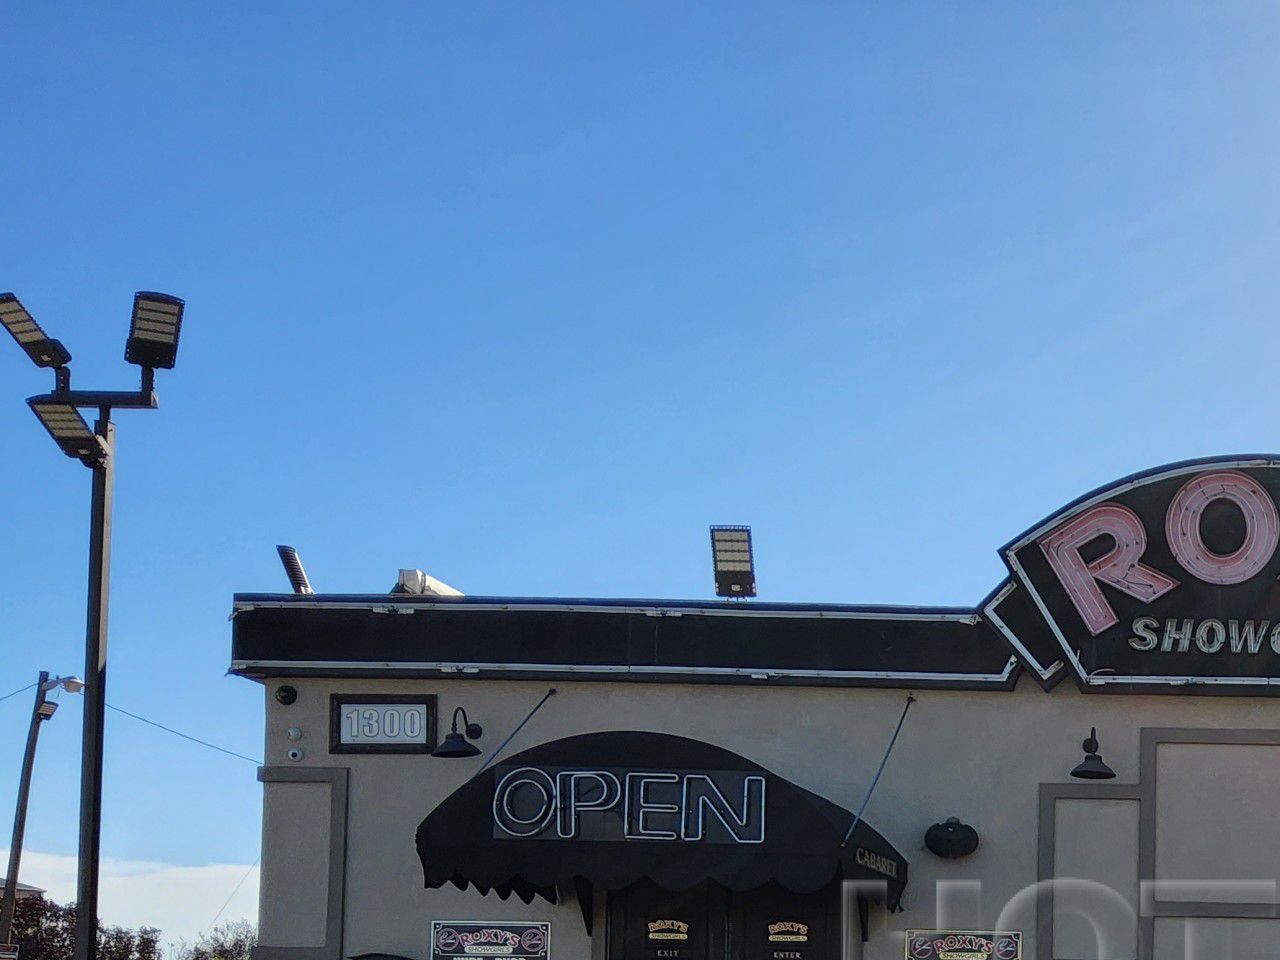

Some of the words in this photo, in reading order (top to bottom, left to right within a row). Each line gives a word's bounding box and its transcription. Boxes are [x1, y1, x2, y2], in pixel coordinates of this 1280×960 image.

[345, 708, 423, 738] 1300
[493, 767, 766, 843] OPEN
[856, 848, 896, 877] CABARET
[648, 920, 689, 932] ROXY'S
[768, 922, 808, 934] ROXY'S
[460, 929, 520, 947] ROXY'S
[933, 935, 995, 954] ROXY'S
[657, 950, 679, 958] EXIT
